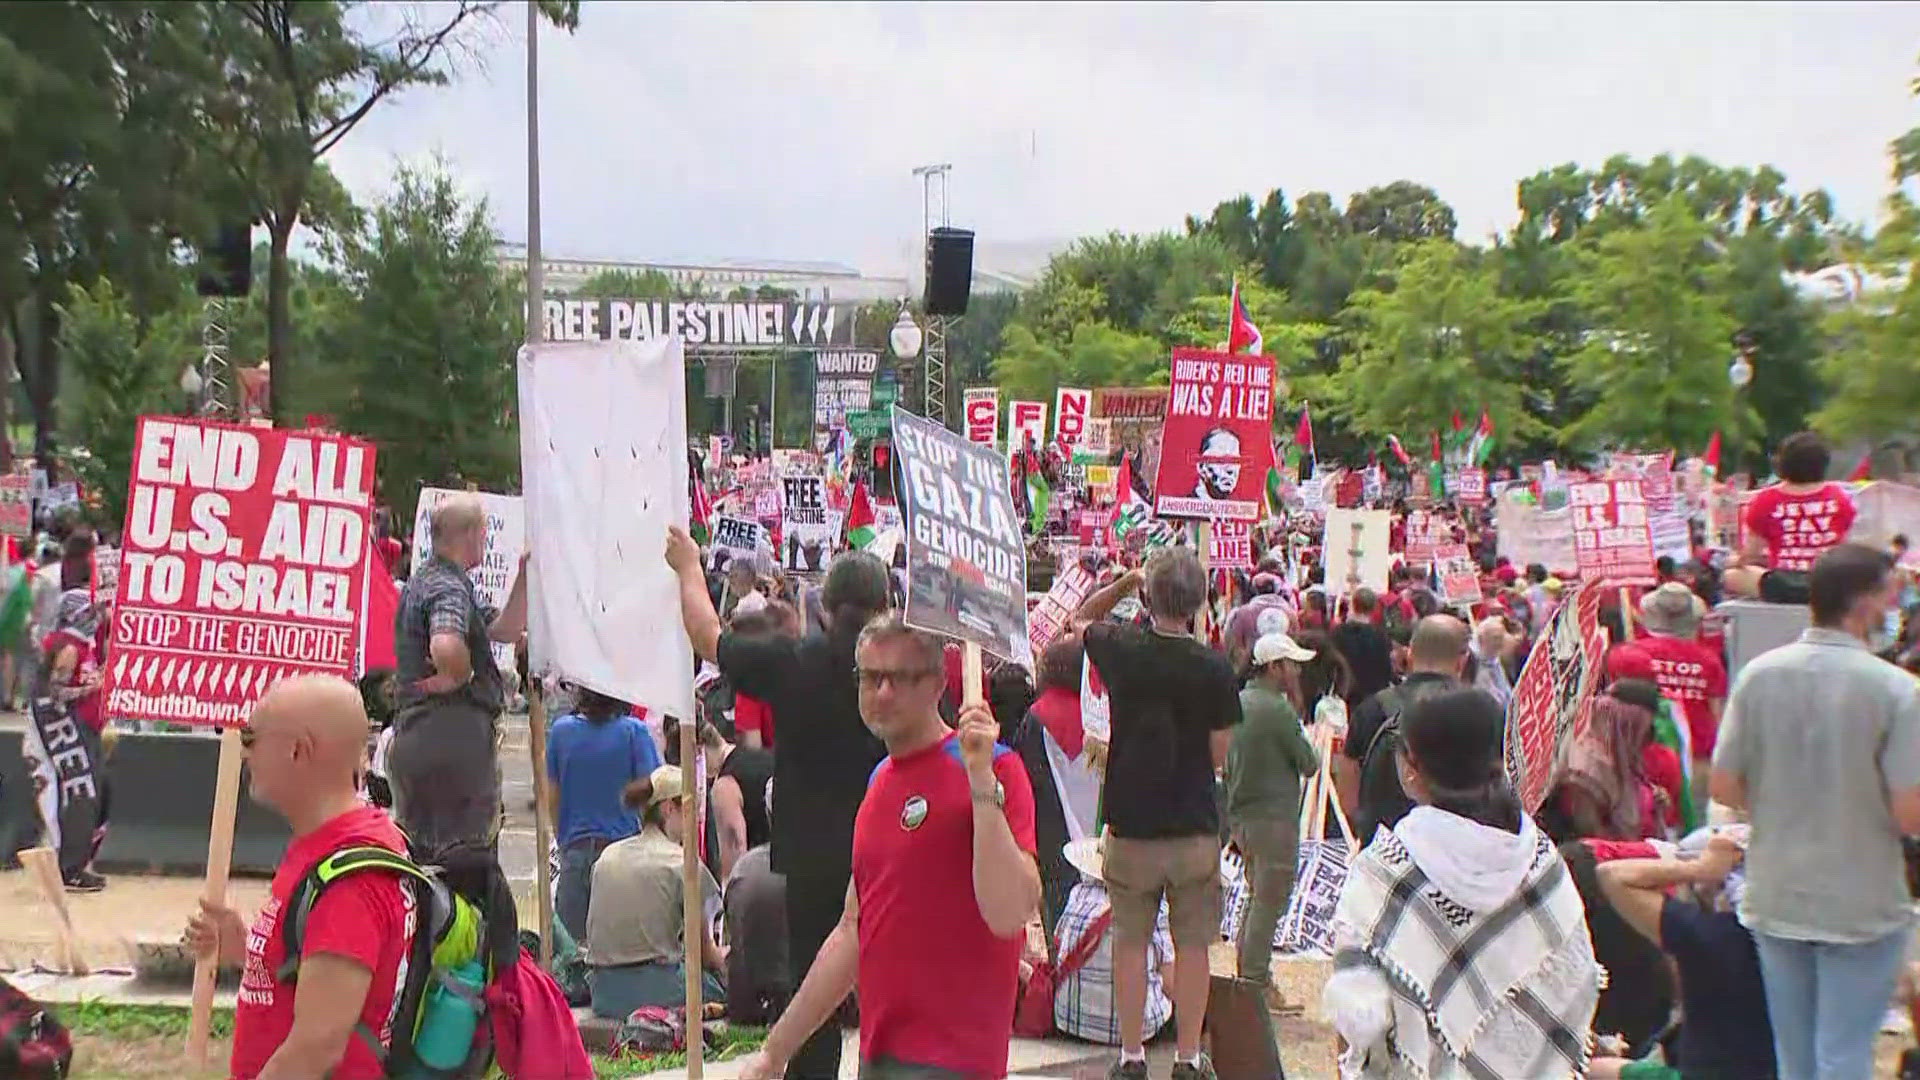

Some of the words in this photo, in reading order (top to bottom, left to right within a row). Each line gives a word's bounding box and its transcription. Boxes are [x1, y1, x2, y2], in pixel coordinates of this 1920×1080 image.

[528, 301, 600, 341] REE
[610, 302, 784, 343] PALESTINE!
[816, 352, 877, 372] WANTED
[1175, 359, 1219, 382] BIDEN'S
[1223, 364, 1245, 384] RED
[1247, 366, 1270, 388] LINE
[1172, 384, 1214, 416] WAS
[1218, 387, 1232, 419] A
[1236, 389, 1270, 421] LIE!
[967, 401, 995, 448] CE
[138, 421, 259, 491] END
[273, 439, 368, 507] ALL
[899, 423, 957, 467] STOP
[967, 453, 1005, 492] THE
[783, 477, 821, 508] FREE
[908, 457, 1017, 547] GAZA
[1771, 500, 1838, 518] JEWS
[130, 485, 243, 557] U.S.
[260, 501, 363, 568] AID
[718, 518, 757, 541] FREE
[1782, 531, 1837, 546] STOP
[915, 513, 1022, 585] GENOCIDE
[125, 552, 185, 605] TO
[196, 560, 354, 621] ISRAEL
[117, 612, 181, 647] STOP
[187, 619, 231, 652] THE
[236, 625, 350, 664] GENOCIDE
[1650, 659, 1703, 674] STOP
[108, 688, 257, 722] #ShutItDown4
